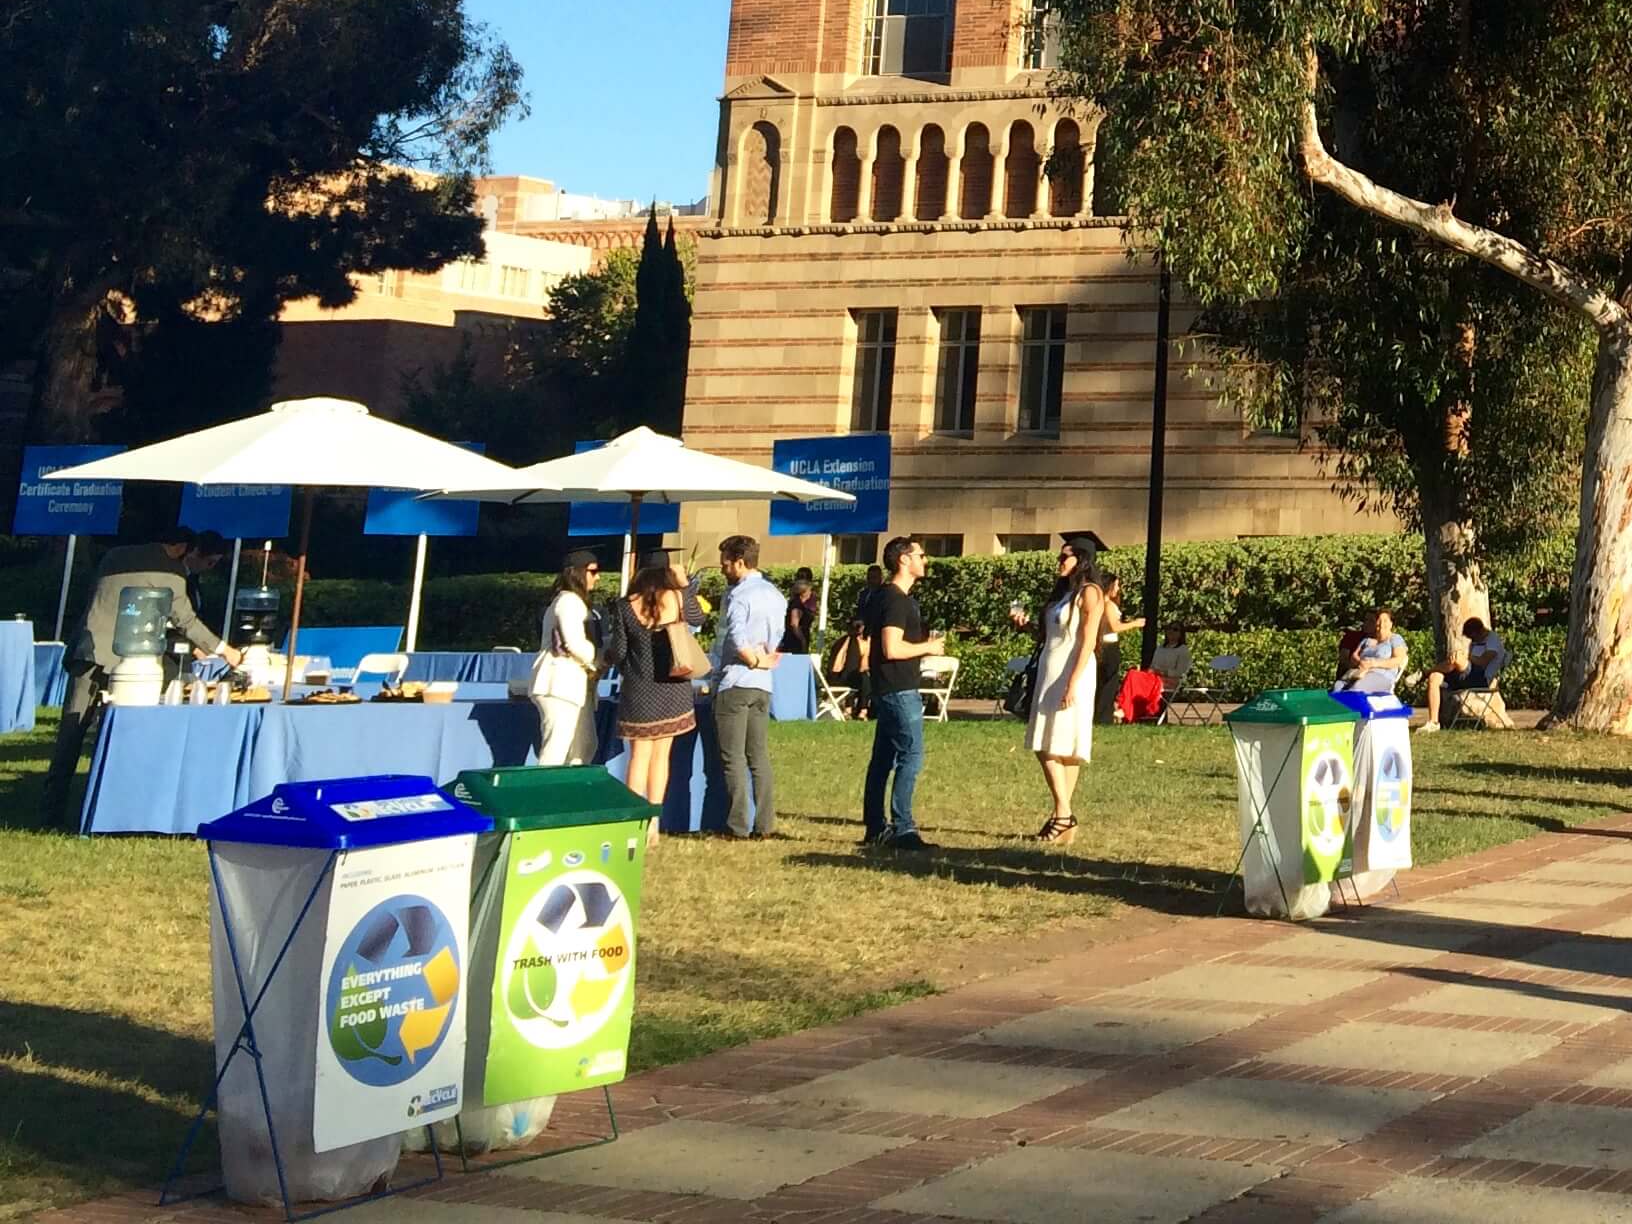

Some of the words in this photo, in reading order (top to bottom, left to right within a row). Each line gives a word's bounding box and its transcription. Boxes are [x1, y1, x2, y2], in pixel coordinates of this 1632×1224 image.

[790, 459, 820, 475] UCLA
[823, 458, 875, 473] Extension
[20, 482, 71, 496] Certificate
[73, 482, 123, 496] Graduation
[833, 476, 889, 490] Graduation
[48, 499, 95, 515] Ceremony
[513, 956, 552, 970] TRASH
[557, 951, 588, 964] WITH
[592, 946, 624, 959] FOOD
[341, 962, 422, 990] EVERYTHING
[340, 987, 391, 1010] EXCEPT
[340, 1009, 376, 1028] FOOD
[379, 998, 425, 1020] WASTE
